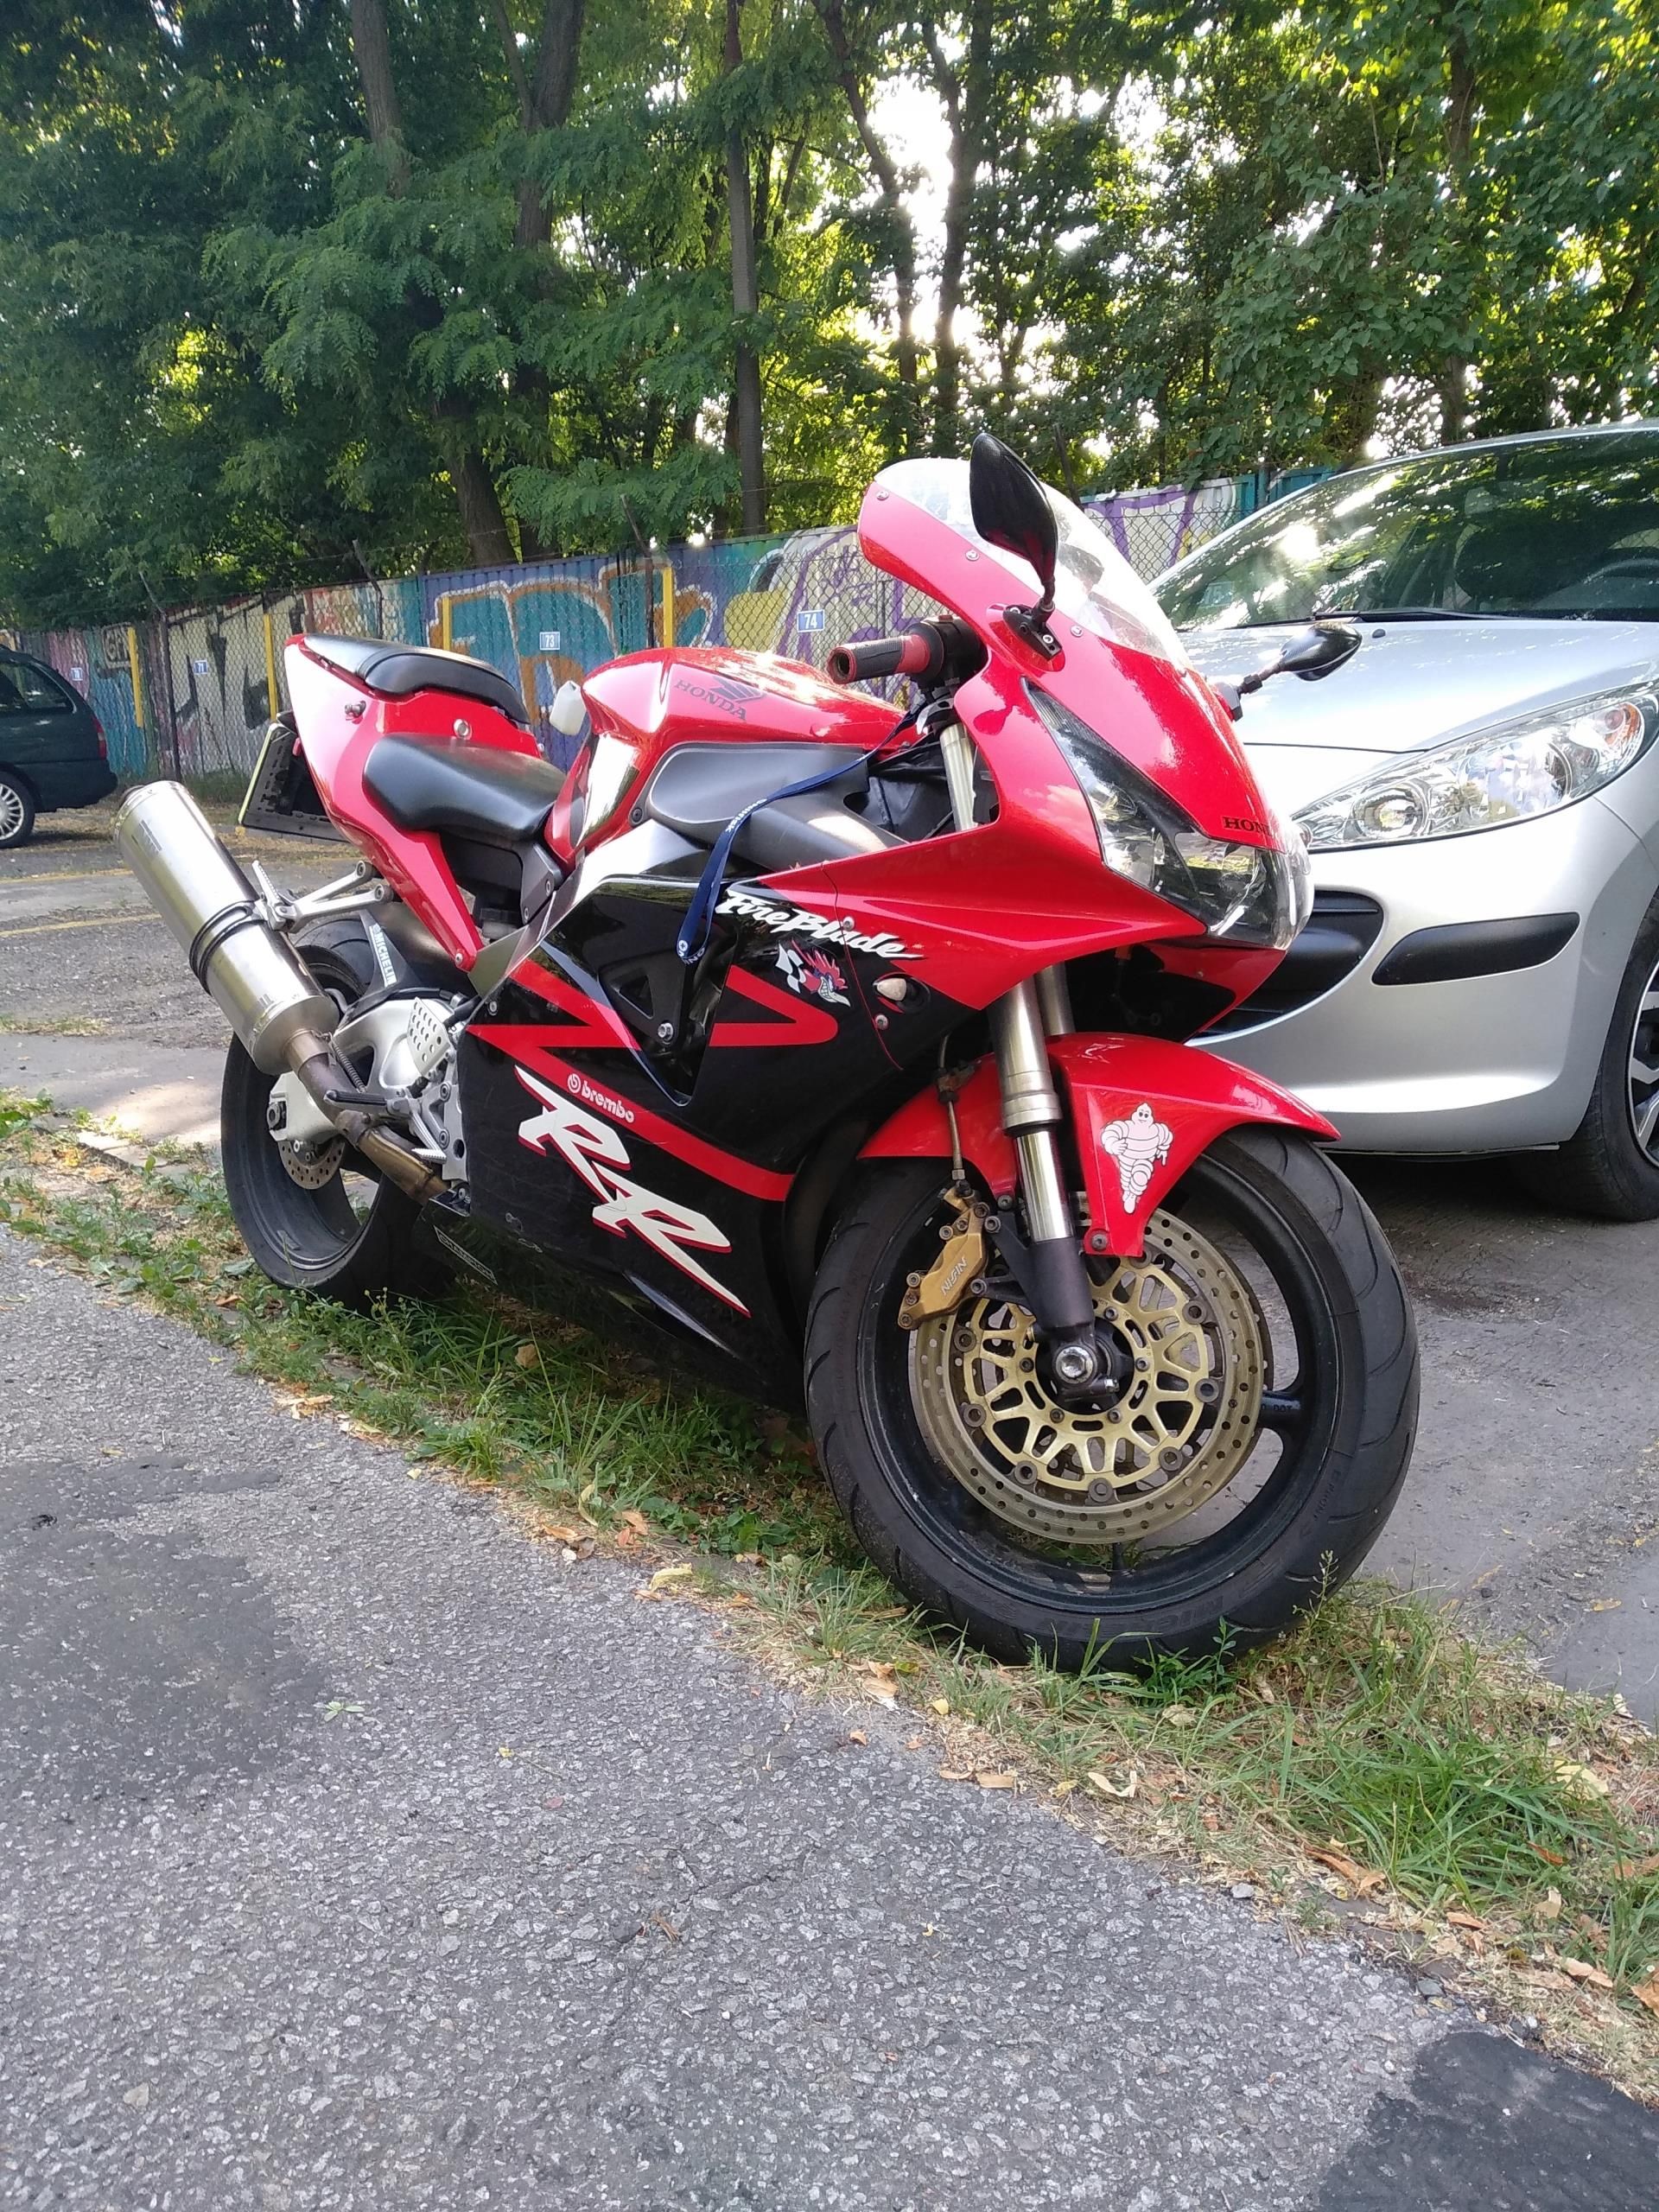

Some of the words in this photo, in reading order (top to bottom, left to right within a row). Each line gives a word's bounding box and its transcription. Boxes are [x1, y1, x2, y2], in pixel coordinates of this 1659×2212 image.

[545, 634, 555, 648] 73
[804, 613, 817, 629] 74
[675, 679, 747, 721] HONDA
[582, 1079, 635, 1123] brembo
[514, 1065, 752, 1319] RR
